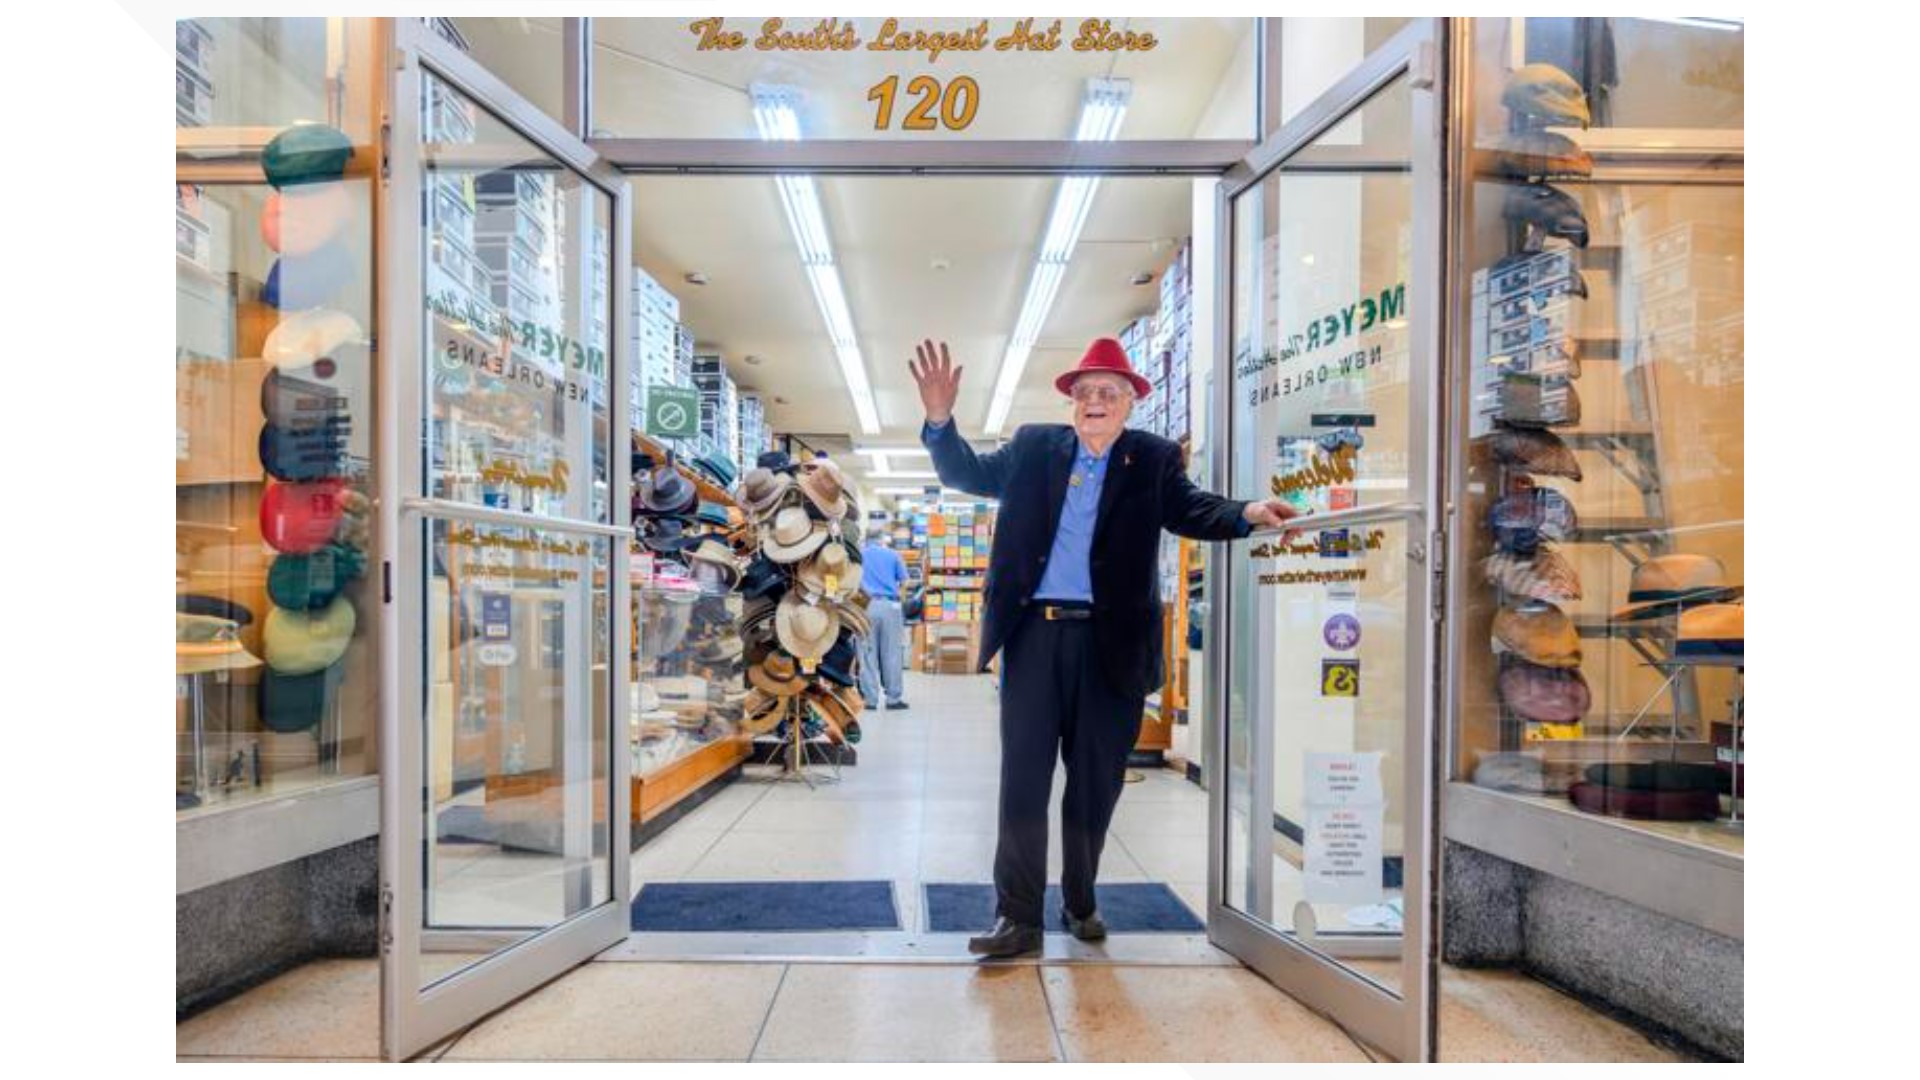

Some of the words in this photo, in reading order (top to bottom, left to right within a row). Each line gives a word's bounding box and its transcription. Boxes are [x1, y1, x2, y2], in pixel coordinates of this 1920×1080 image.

[690, 17, 747, 51] The
[867, 17, 988, 63] Largest
[994, 17, 1061, 51] Hat
[1072, 18, 1158, 51] Store
[867, 75, 980, 131] 120
